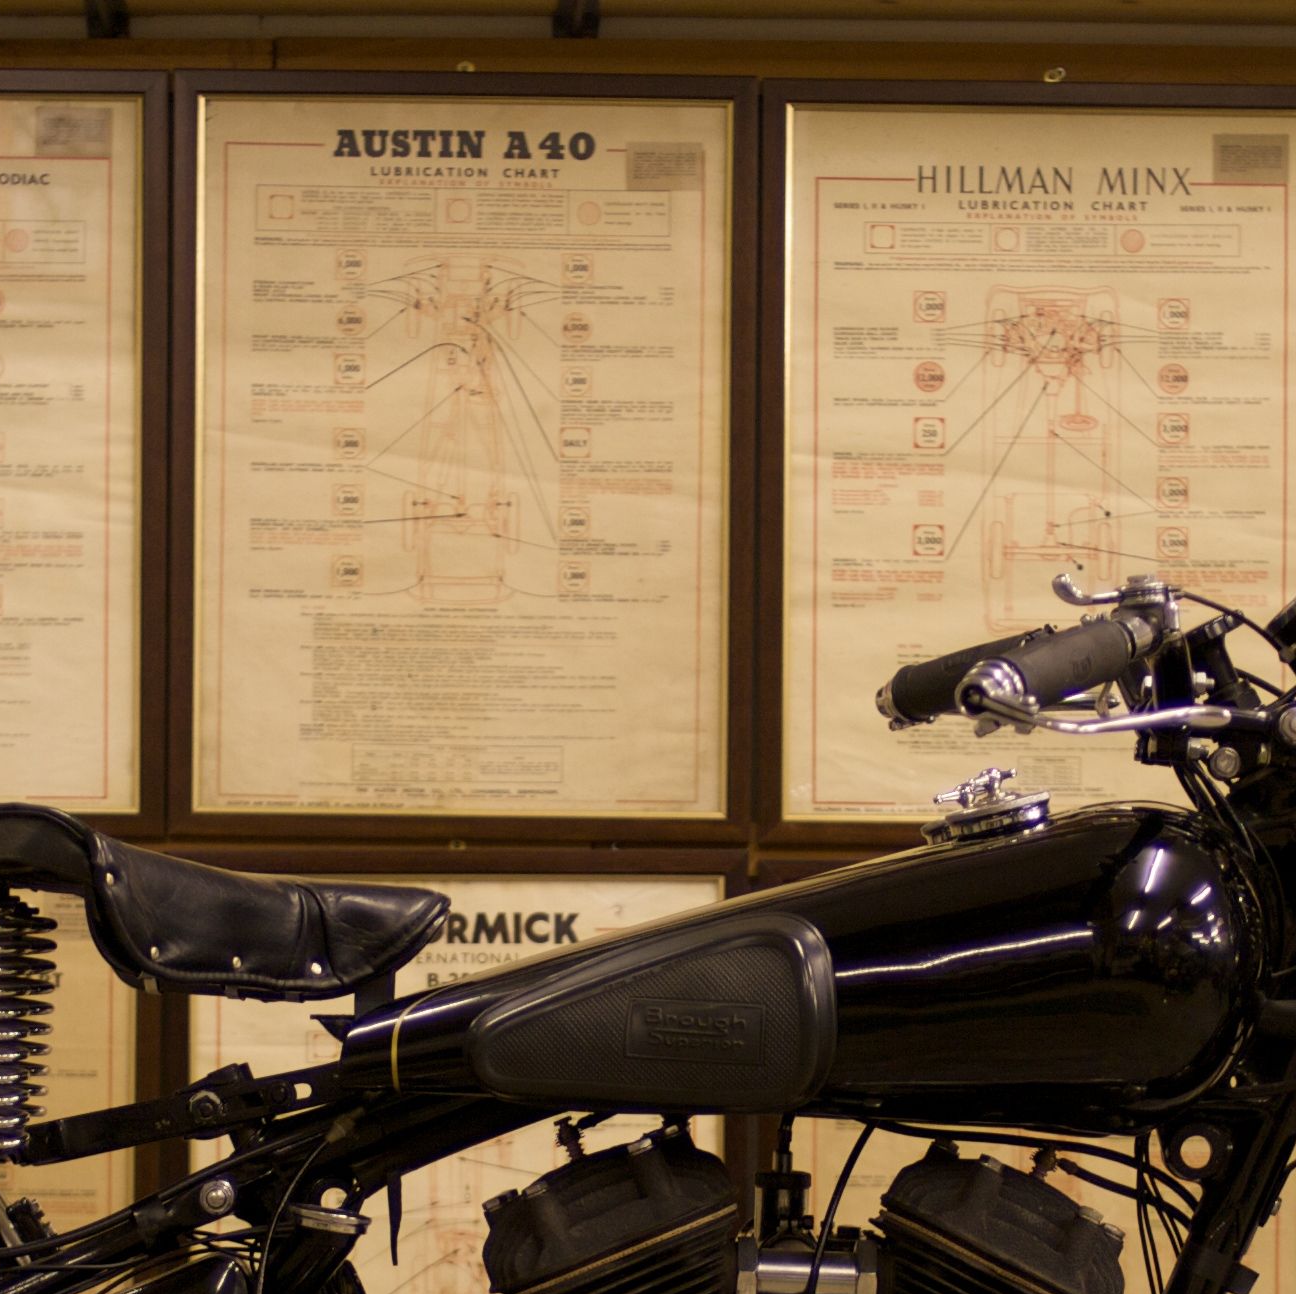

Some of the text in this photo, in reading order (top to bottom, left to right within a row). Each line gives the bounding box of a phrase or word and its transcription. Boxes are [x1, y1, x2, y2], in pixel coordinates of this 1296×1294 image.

[334, 129, 595, 160] AUSTIN A40
[370, 166, 561, 179] LUBRICATION CHART
[917, 165, 1192, 196] HILLMAN MINX
[958, 200, 1149, 213] LUBRICATION CHART
